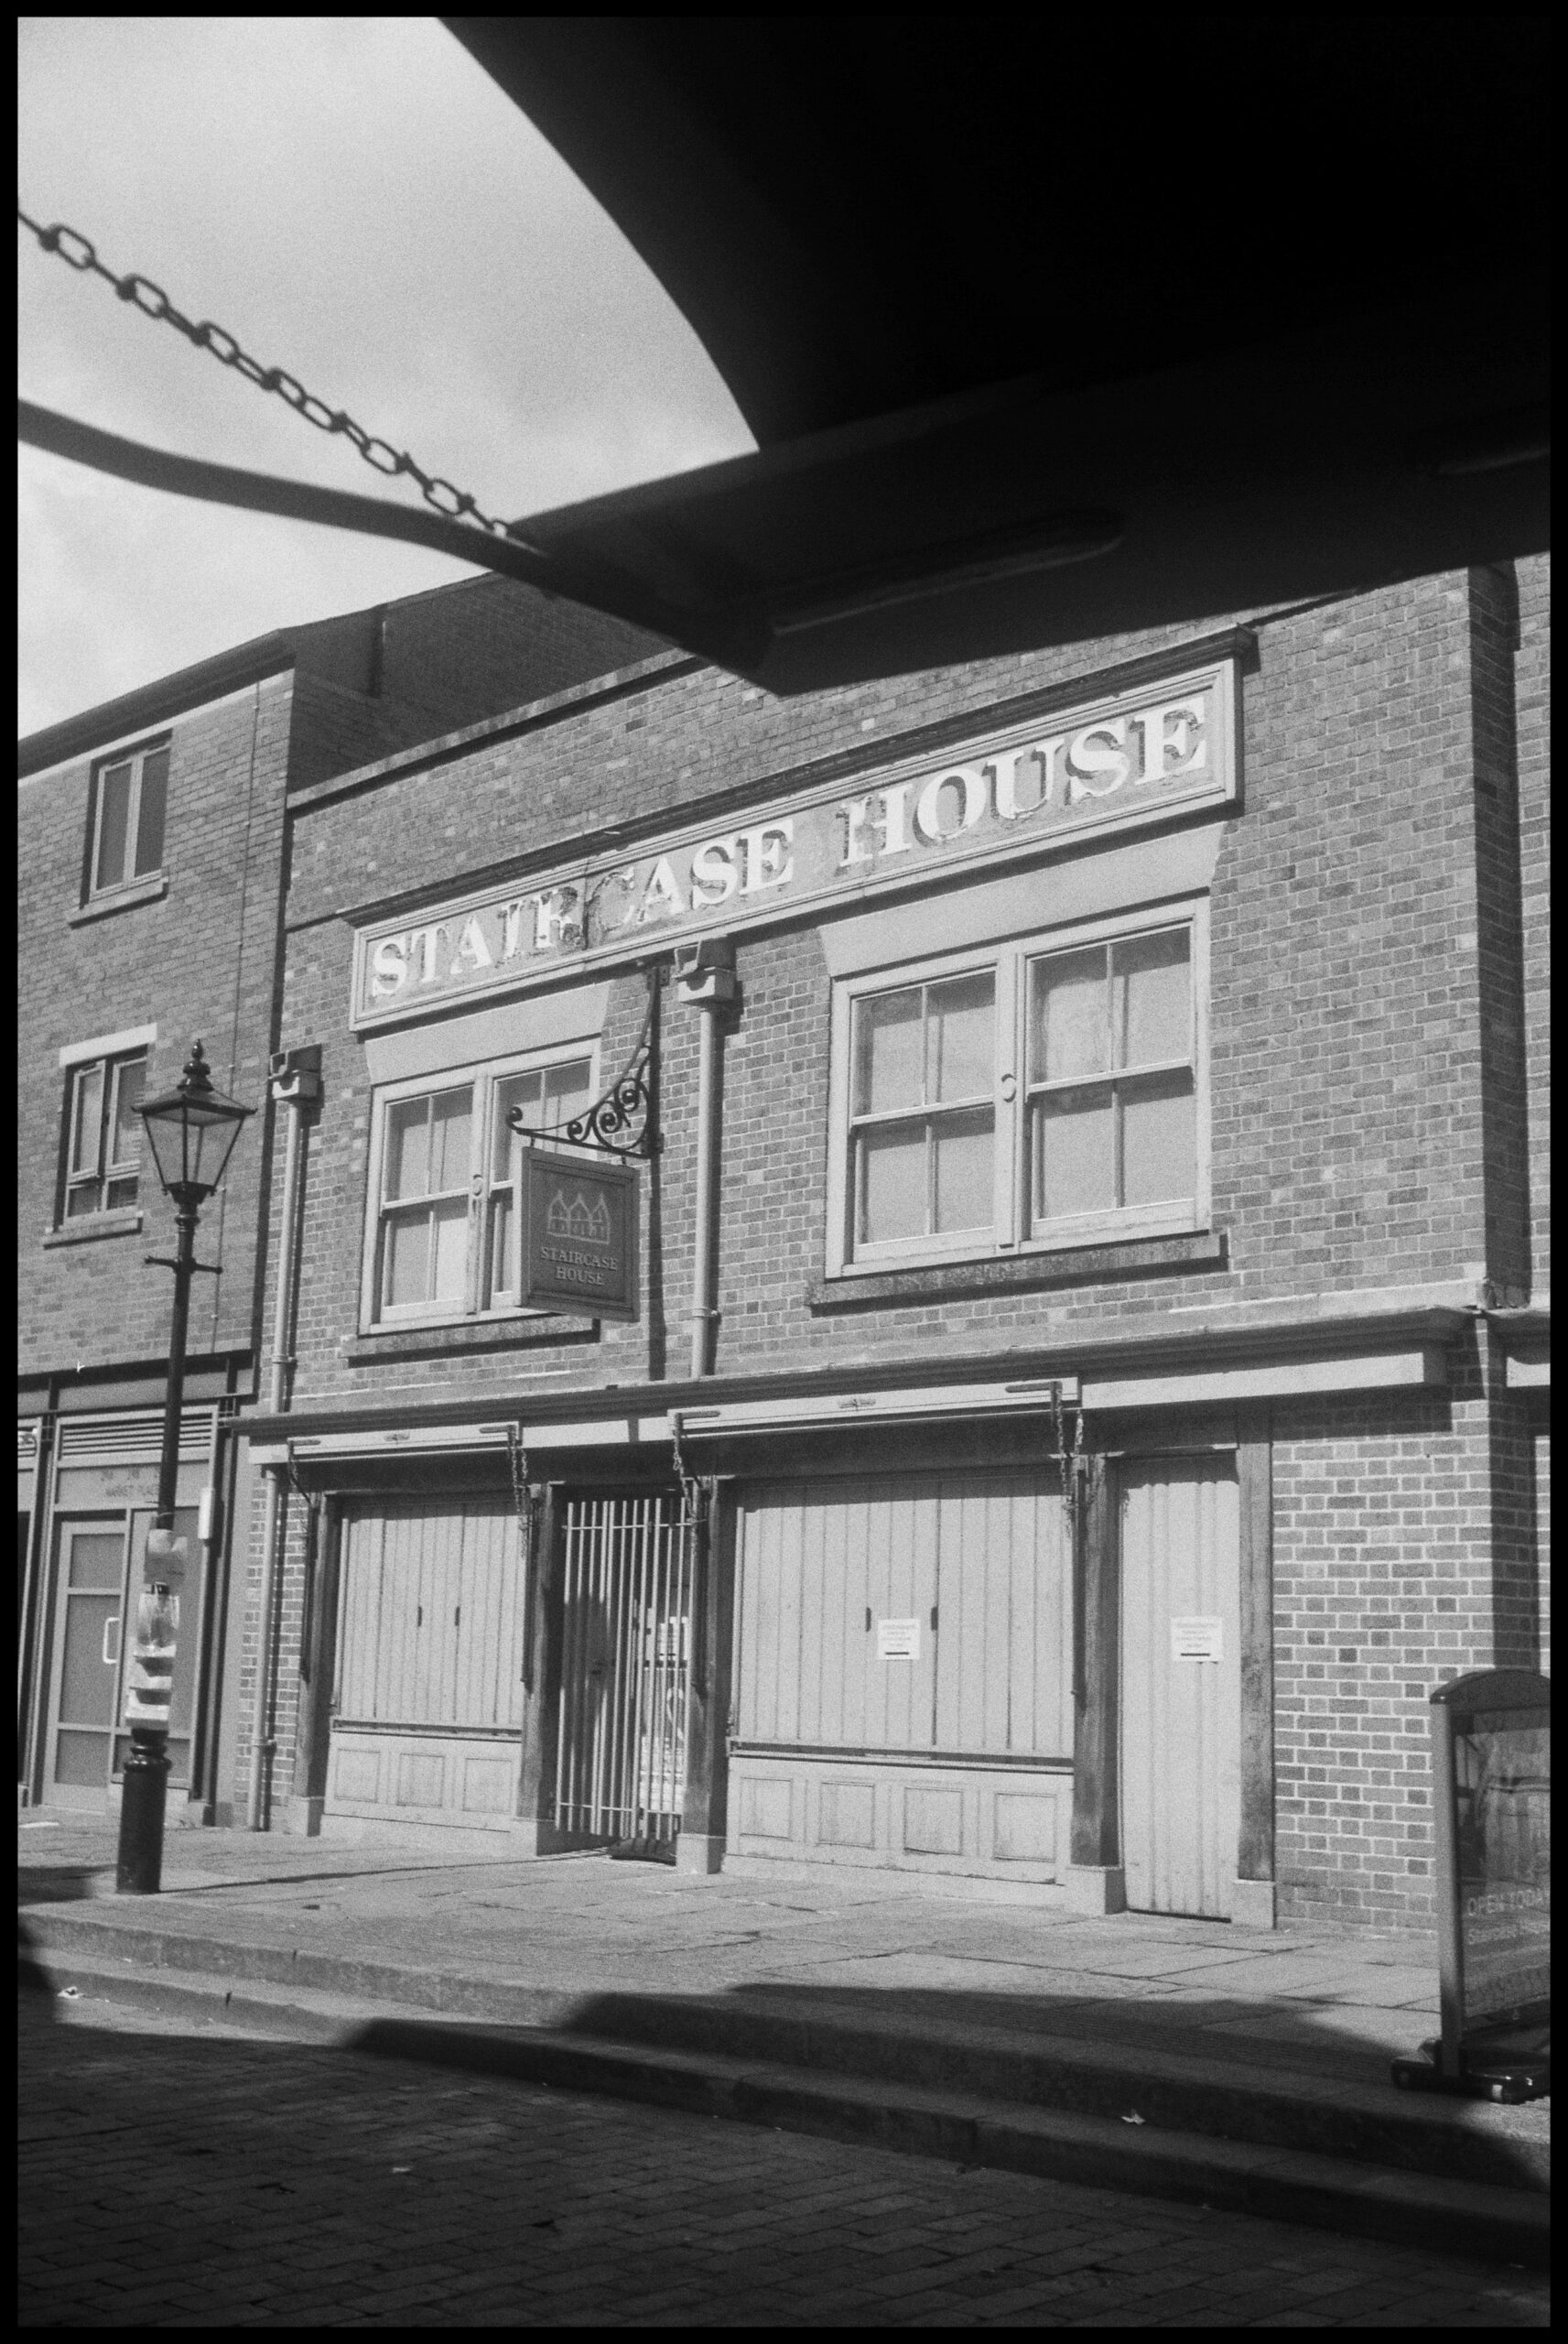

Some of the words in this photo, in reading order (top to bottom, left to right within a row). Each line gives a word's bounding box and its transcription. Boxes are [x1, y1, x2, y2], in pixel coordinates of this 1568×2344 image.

[371, 819, 795, 997] STAIRCASE
[837, 696, 1207, 868] HOUSE
[541, 1245, 619, 1270] STAIRCASE
[556, 1265, 605, 1286] HOUSE
